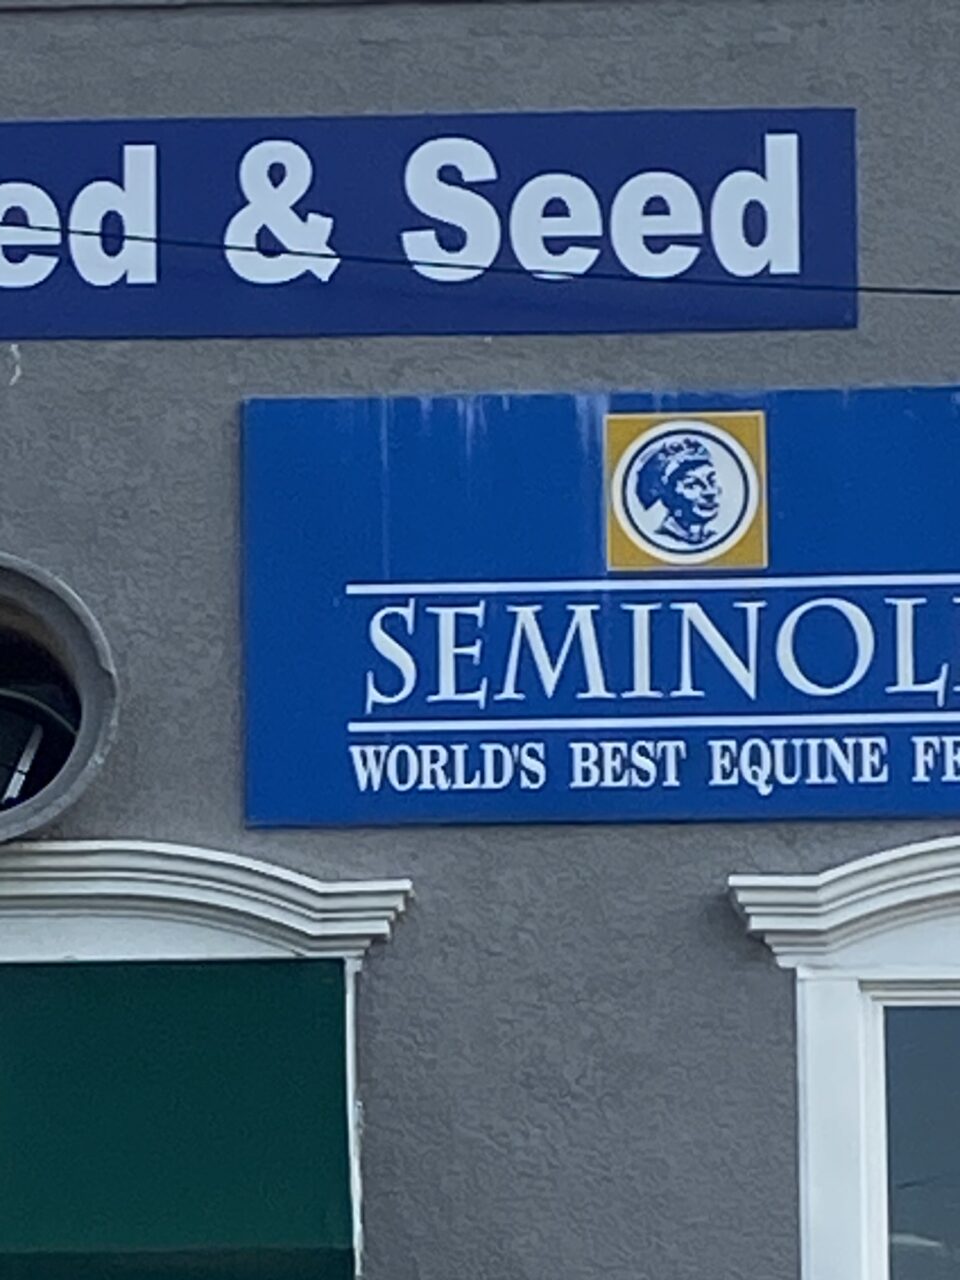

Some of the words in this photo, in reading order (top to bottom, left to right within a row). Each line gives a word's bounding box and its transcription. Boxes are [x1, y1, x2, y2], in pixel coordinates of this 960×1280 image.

[224, 139, 341, 284] &
[401, 133, 801, 282] Seed
[365, 597, 960, 715] SEMINOL
[349, 742, 546, 791] WORLD'S
[569, 740, 686, 788] BEST
[708, 737, 889, 796] EQUINE
